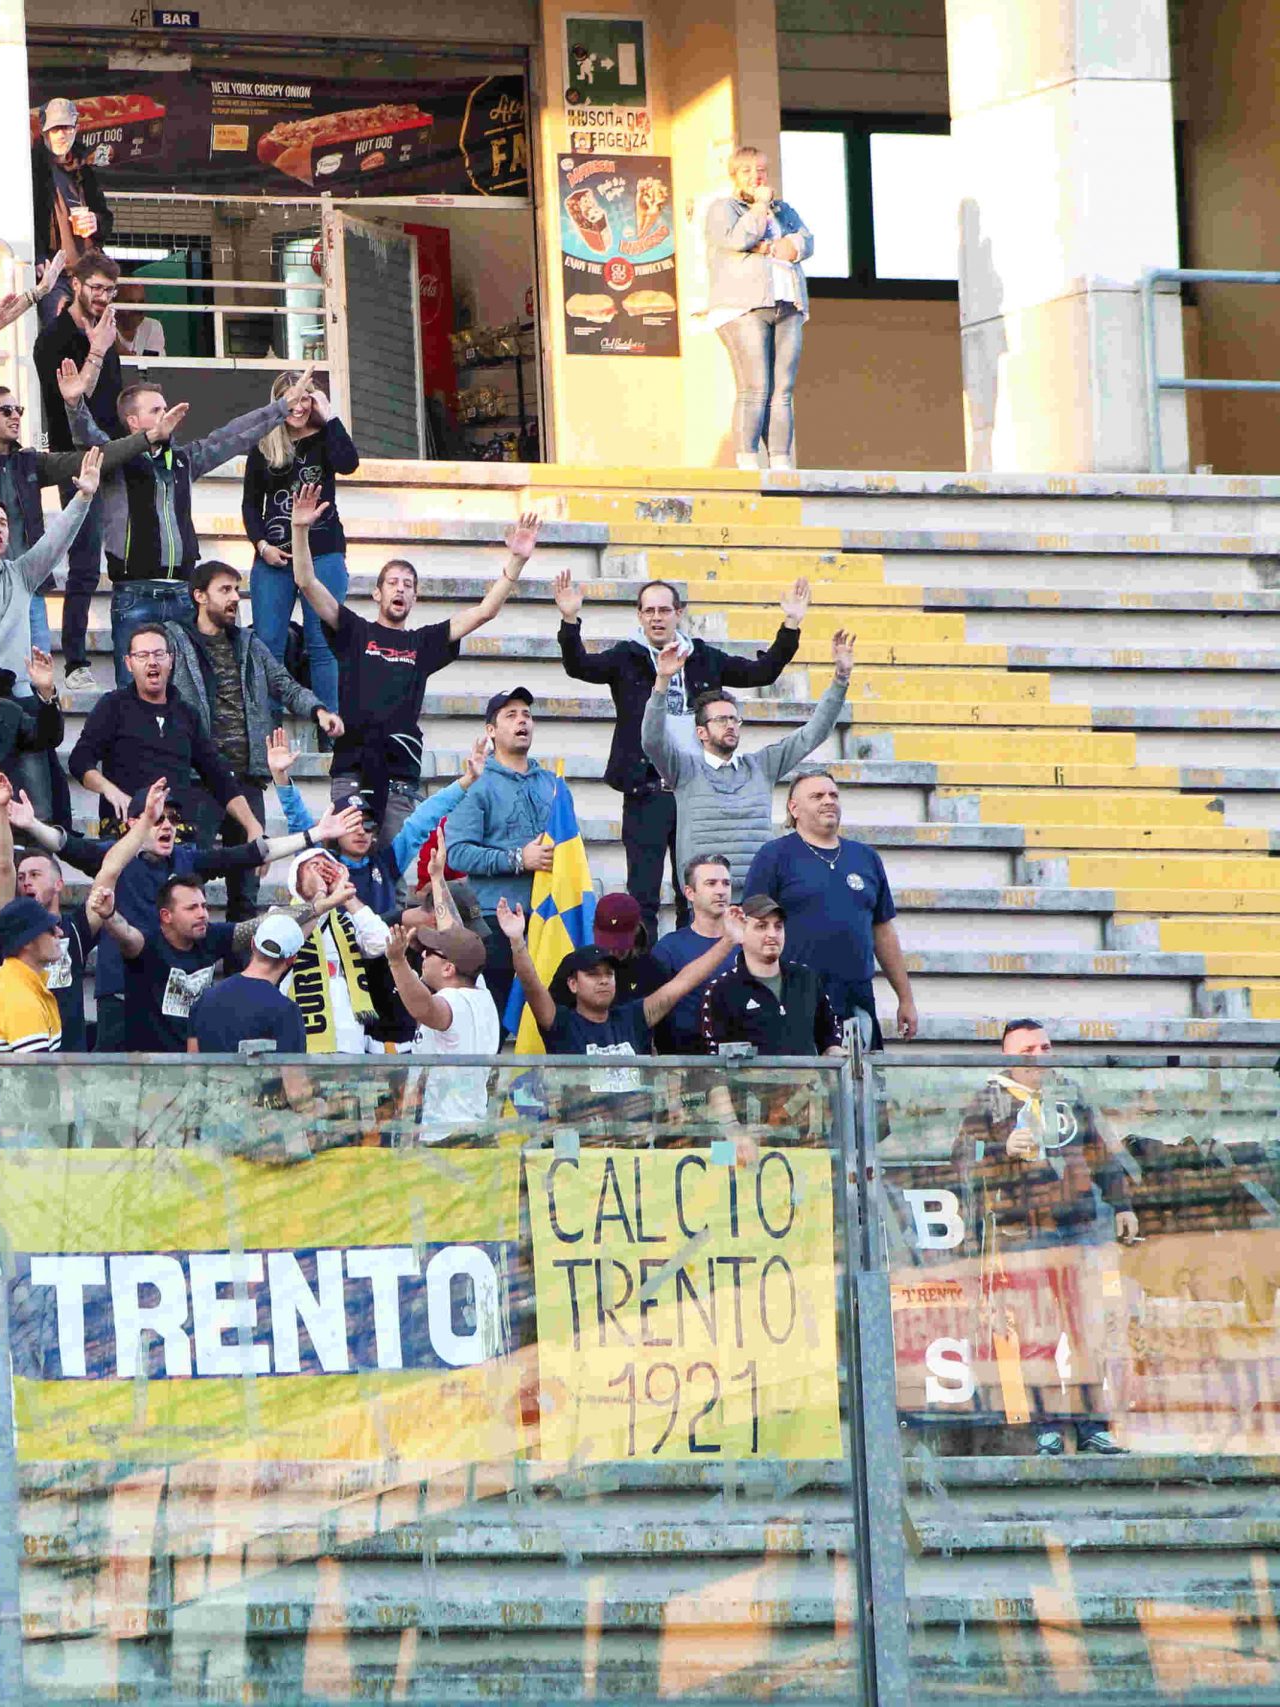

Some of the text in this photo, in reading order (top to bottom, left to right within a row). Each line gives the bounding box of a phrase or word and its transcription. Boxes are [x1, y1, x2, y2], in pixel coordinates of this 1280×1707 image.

[162, 13, 191, 25] BAR
[211, 81, 311, 98] NEW YORK CRISPY ONION
[104, 128, 123, 142] DOG
[355, 135, 393, 156] HOT DOG
[544, 1151, 797, 1245] CALCIO
[902, 1189, 966, 1250] B
[29, 1245, 503, 1379] TRENTO
[551, 1254, 798, 1354] TRENTO
[925, 1336, 976, 1403] S
[607, 1359, 760, 1457] 1921
